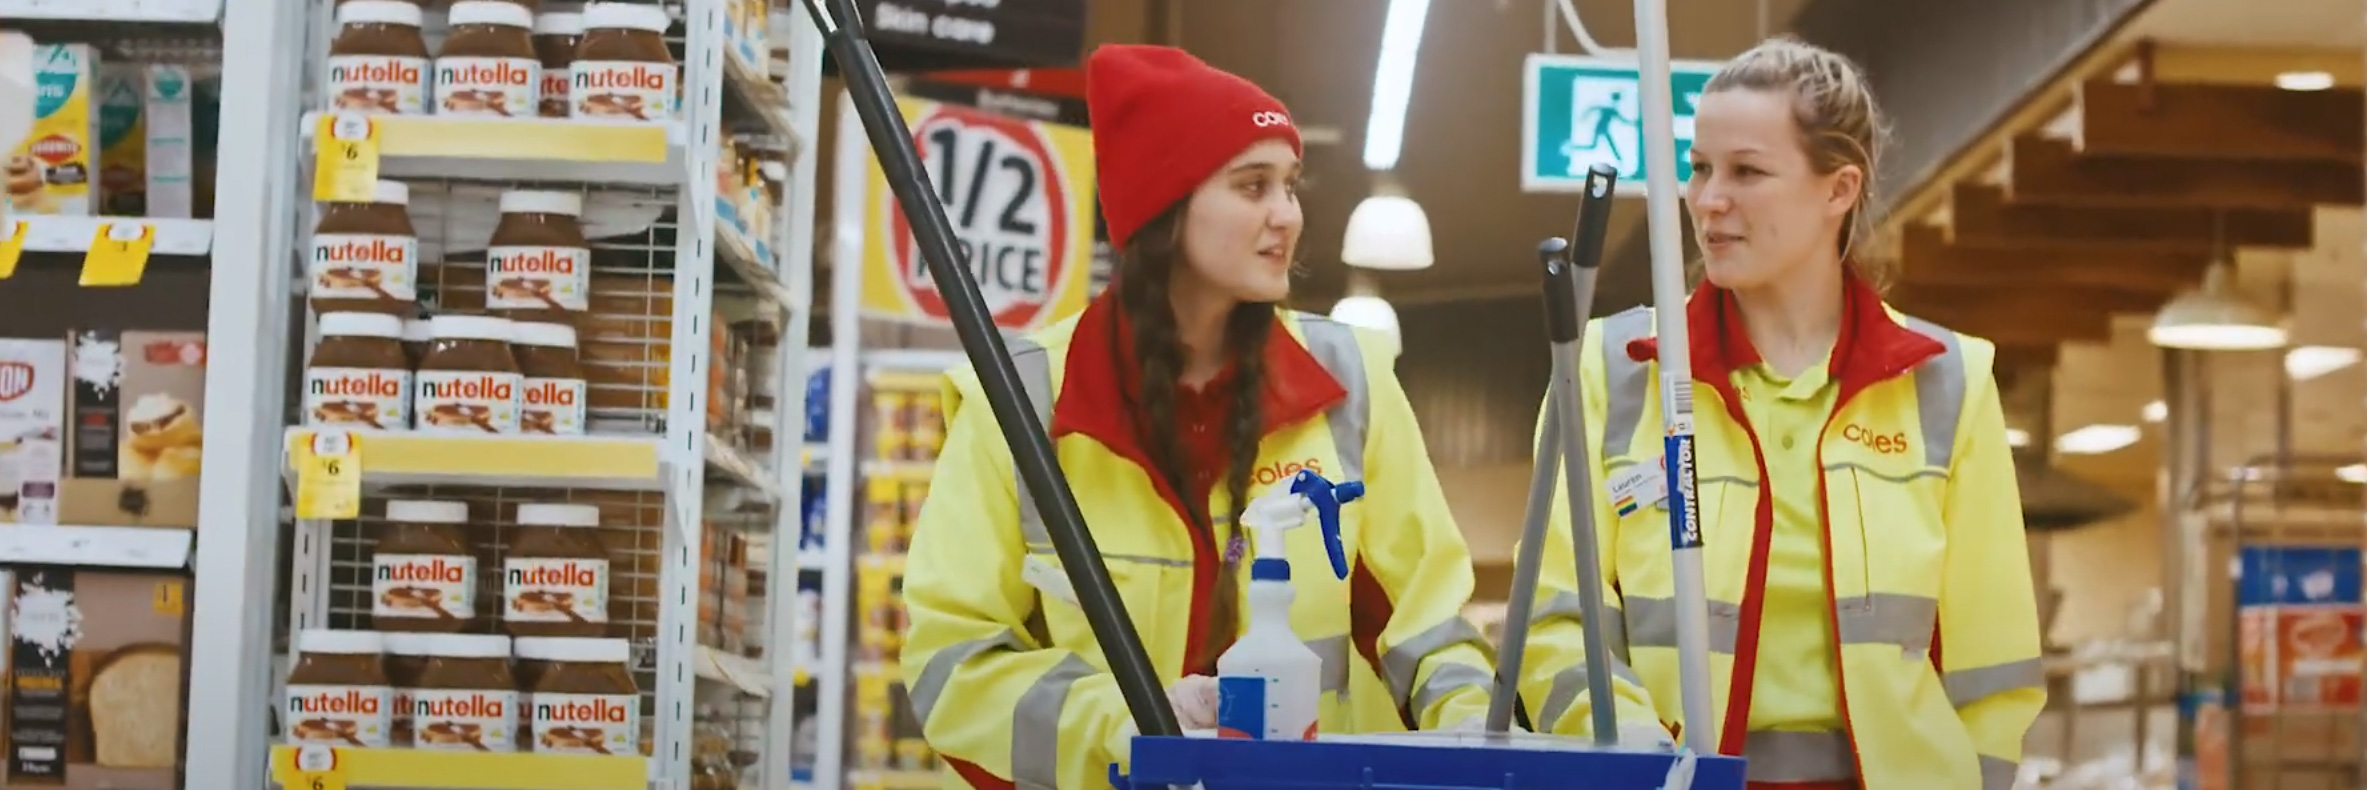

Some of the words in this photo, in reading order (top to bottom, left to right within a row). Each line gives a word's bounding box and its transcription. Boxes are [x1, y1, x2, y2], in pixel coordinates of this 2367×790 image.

[332, 61, 418, 84] nutella
[440, 63, 528, 84] nutella
[575, 68, 663, 90] nutella
[931, 127, 1035, 234] 1/2
[316, 241, 404, 263] nutella
[490, 251, 573, 275] nutella
[917, 238, 1041, 293] ICE
[311, 374, 398, 396] nutella
[422, 377, 512, 401] nutella
[523, 382, 573, 405] ella
[1843, 424, 1907, 454] coles
[378, 560, 463, 583] nutella
[509, 564, 595, 587] nutella
[290, 693, 378, 715] nutella
[417, 695, 503, 717] nutella
[538, 700, 625, 722] nutella
